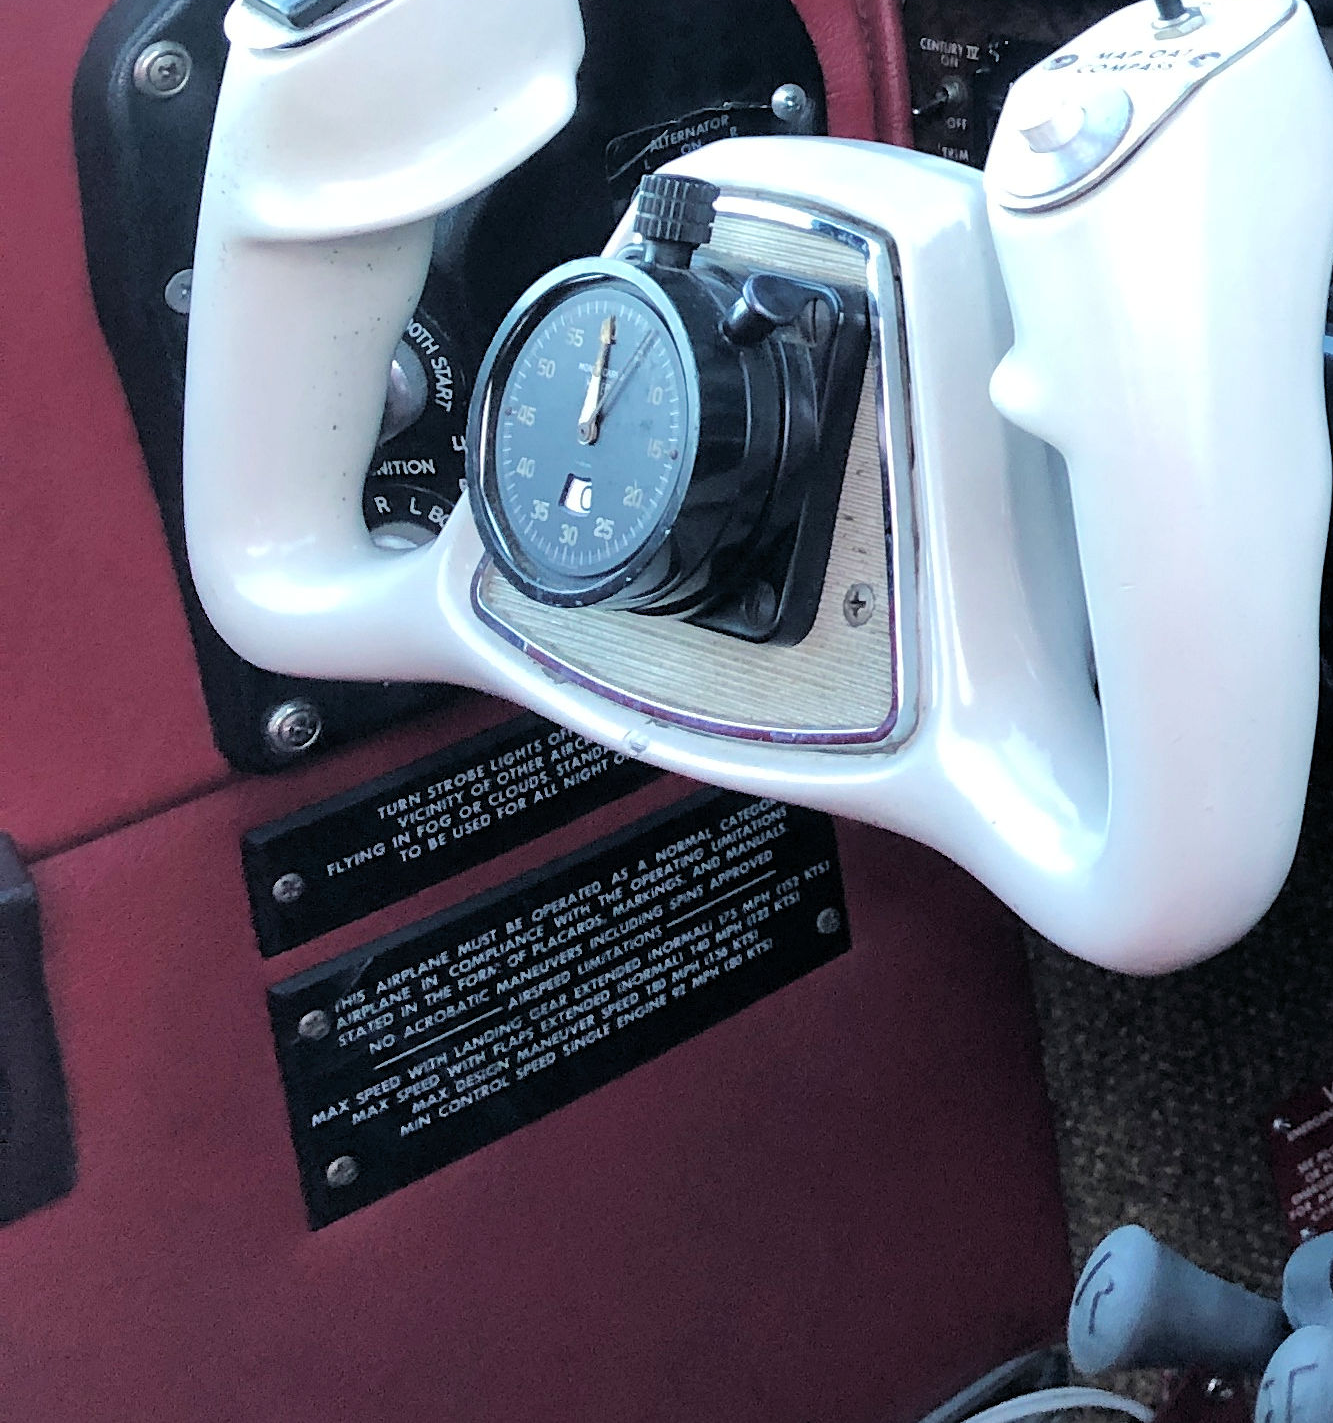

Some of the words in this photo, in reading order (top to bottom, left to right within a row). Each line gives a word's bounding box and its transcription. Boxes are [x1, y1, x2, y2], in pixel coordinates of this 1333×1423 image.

[432, 357, 454, 412] START
[377, 792, 421, 820] TURN
[427, 765, 485, 799] STROBE
[490, 739, 542, 771] LIGHTS
[397, 793, 463, 827] VICINITY
[470, 778, 492, 797] OF
[496, 758, 545, 785] OTHER
[399, 844, 422, 863] TO
[427, 833, 447, 852] BE
[452, 813, 491, 839] USED
[496, 796, 527, 819] FOR
[533, 784, 559, 805] ALL
[563, 759, 608, 790] NIGHT
[326, 842, 386, 877] FLYING
[392, 831, 412, 849] IN
[416, 814, 452, 838] FOG
[459, 801, 483, 818] OR
[369, 1033, 396, 1055] NO
[403, 988, 490, 1039] ACROBATIC
[496, 943, 583, 996] MANEUVERS
[589, 905, 663, 950] INCLUDING
[710, 850, 774, 890] APPROVED
[375, 950, 451, 995] AIRPLANE
[457, 929, 497, 957] MUST
[505, 916, 523, 934] BE
[531, 880, 602, 922] OPERATED
[508, 970, 571, 1010] AIRSPEED
[577, 925, 663, 975] LIMITATIONS
[311, 1098, 351, 1127] MAX
[356, 1075, 401, 1106] SPEED
[407, 1052, 448, 1079] WITH
[453, 1015, 522, 1058] LANDING
[529, 994, 568, 1020] GEAR
